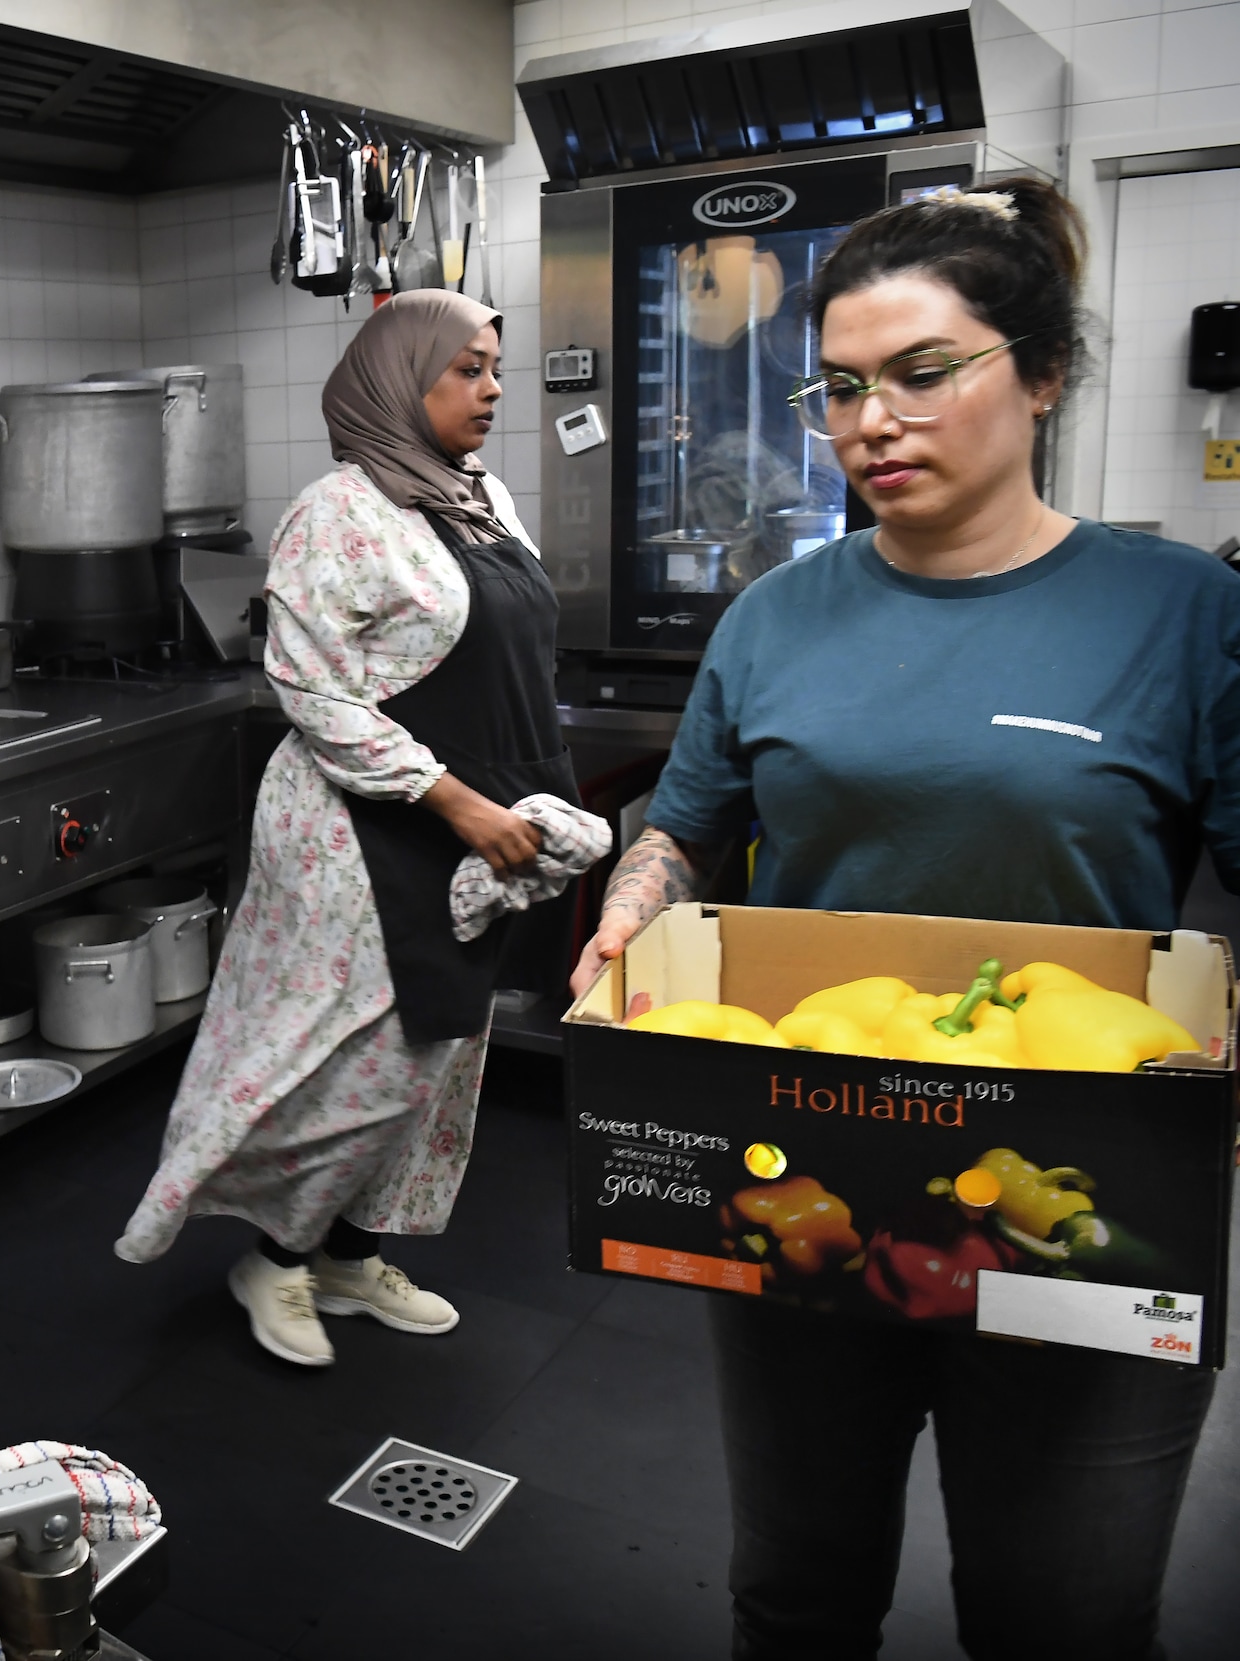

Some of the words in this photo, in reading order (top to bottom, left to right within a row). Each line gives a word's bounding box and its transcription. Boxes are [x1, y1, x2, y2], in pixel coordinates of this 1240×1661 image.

[704, 193, 778, 217] UNOX
[769, 1074, 965, 1127] Holland
[879, 1073, 955, 1098] since
[963, 1081, 1016, 1102] 1915
[579, 1111, 641, 1138] Sweet
[645, 1121, 730, 1152] Peppers
[604, 1159, 701, 1183] passionate
[612, 1147, 671, 1165] selected
[675, 1154, 696, 1171] by
[597, 1174, 712, 1207] growers
